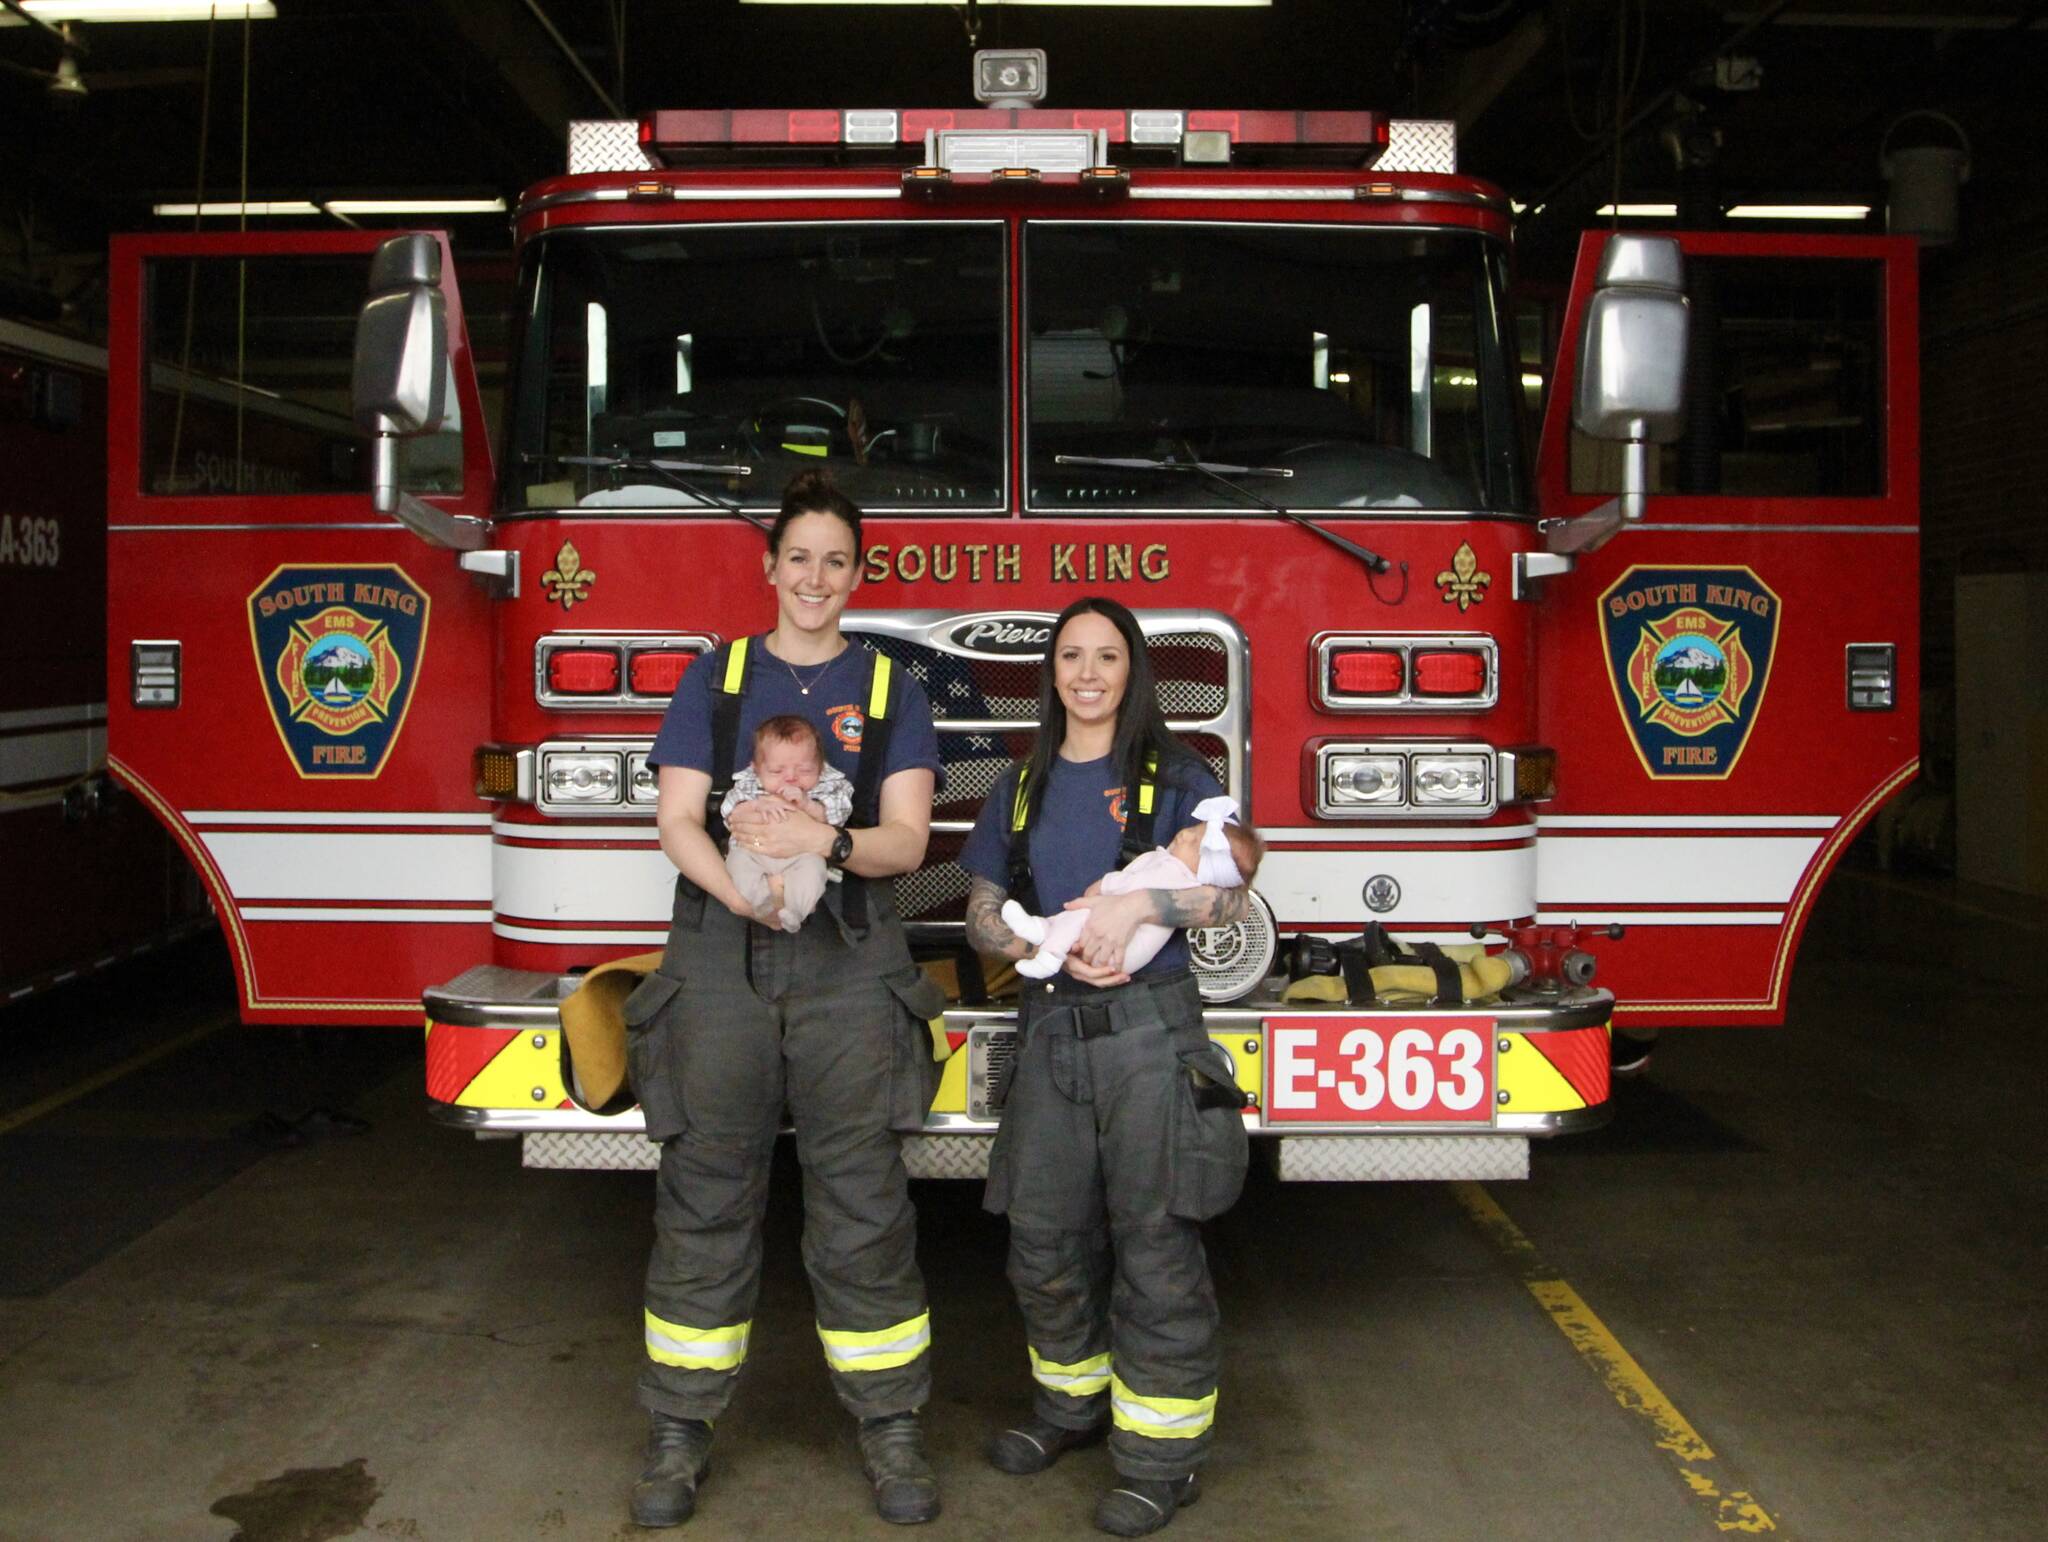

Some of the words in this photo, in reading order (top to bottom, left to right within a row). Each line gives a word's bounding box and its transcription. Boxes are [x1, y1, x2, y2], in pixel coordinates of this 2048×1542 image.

[0, 514, 60, 567] A-363
[864, 543, 1021, 584] SOUTH
[1051, 543, 1170, 584] KING
[258, 582, 345, 617] SOUTH
[354, 583, 418, 616] KING
[1609, 583, 1697, 618] SOUTH
[1706, 584, 1770, 617] KING
[324, 615, 355, 629] EMS
[1676, 616, 1707, 630] EMS
[964, 621, 1049, 648] Pierc
[312, 707, 367, 727] PREVENTION
[1662, 708, 1718, 728] PREVENTION
[312, 745, 367, 765] FIRE
[1663, 746, 1718, 766] FIRE
[1273, 1028, 1485, 1111] E-363
